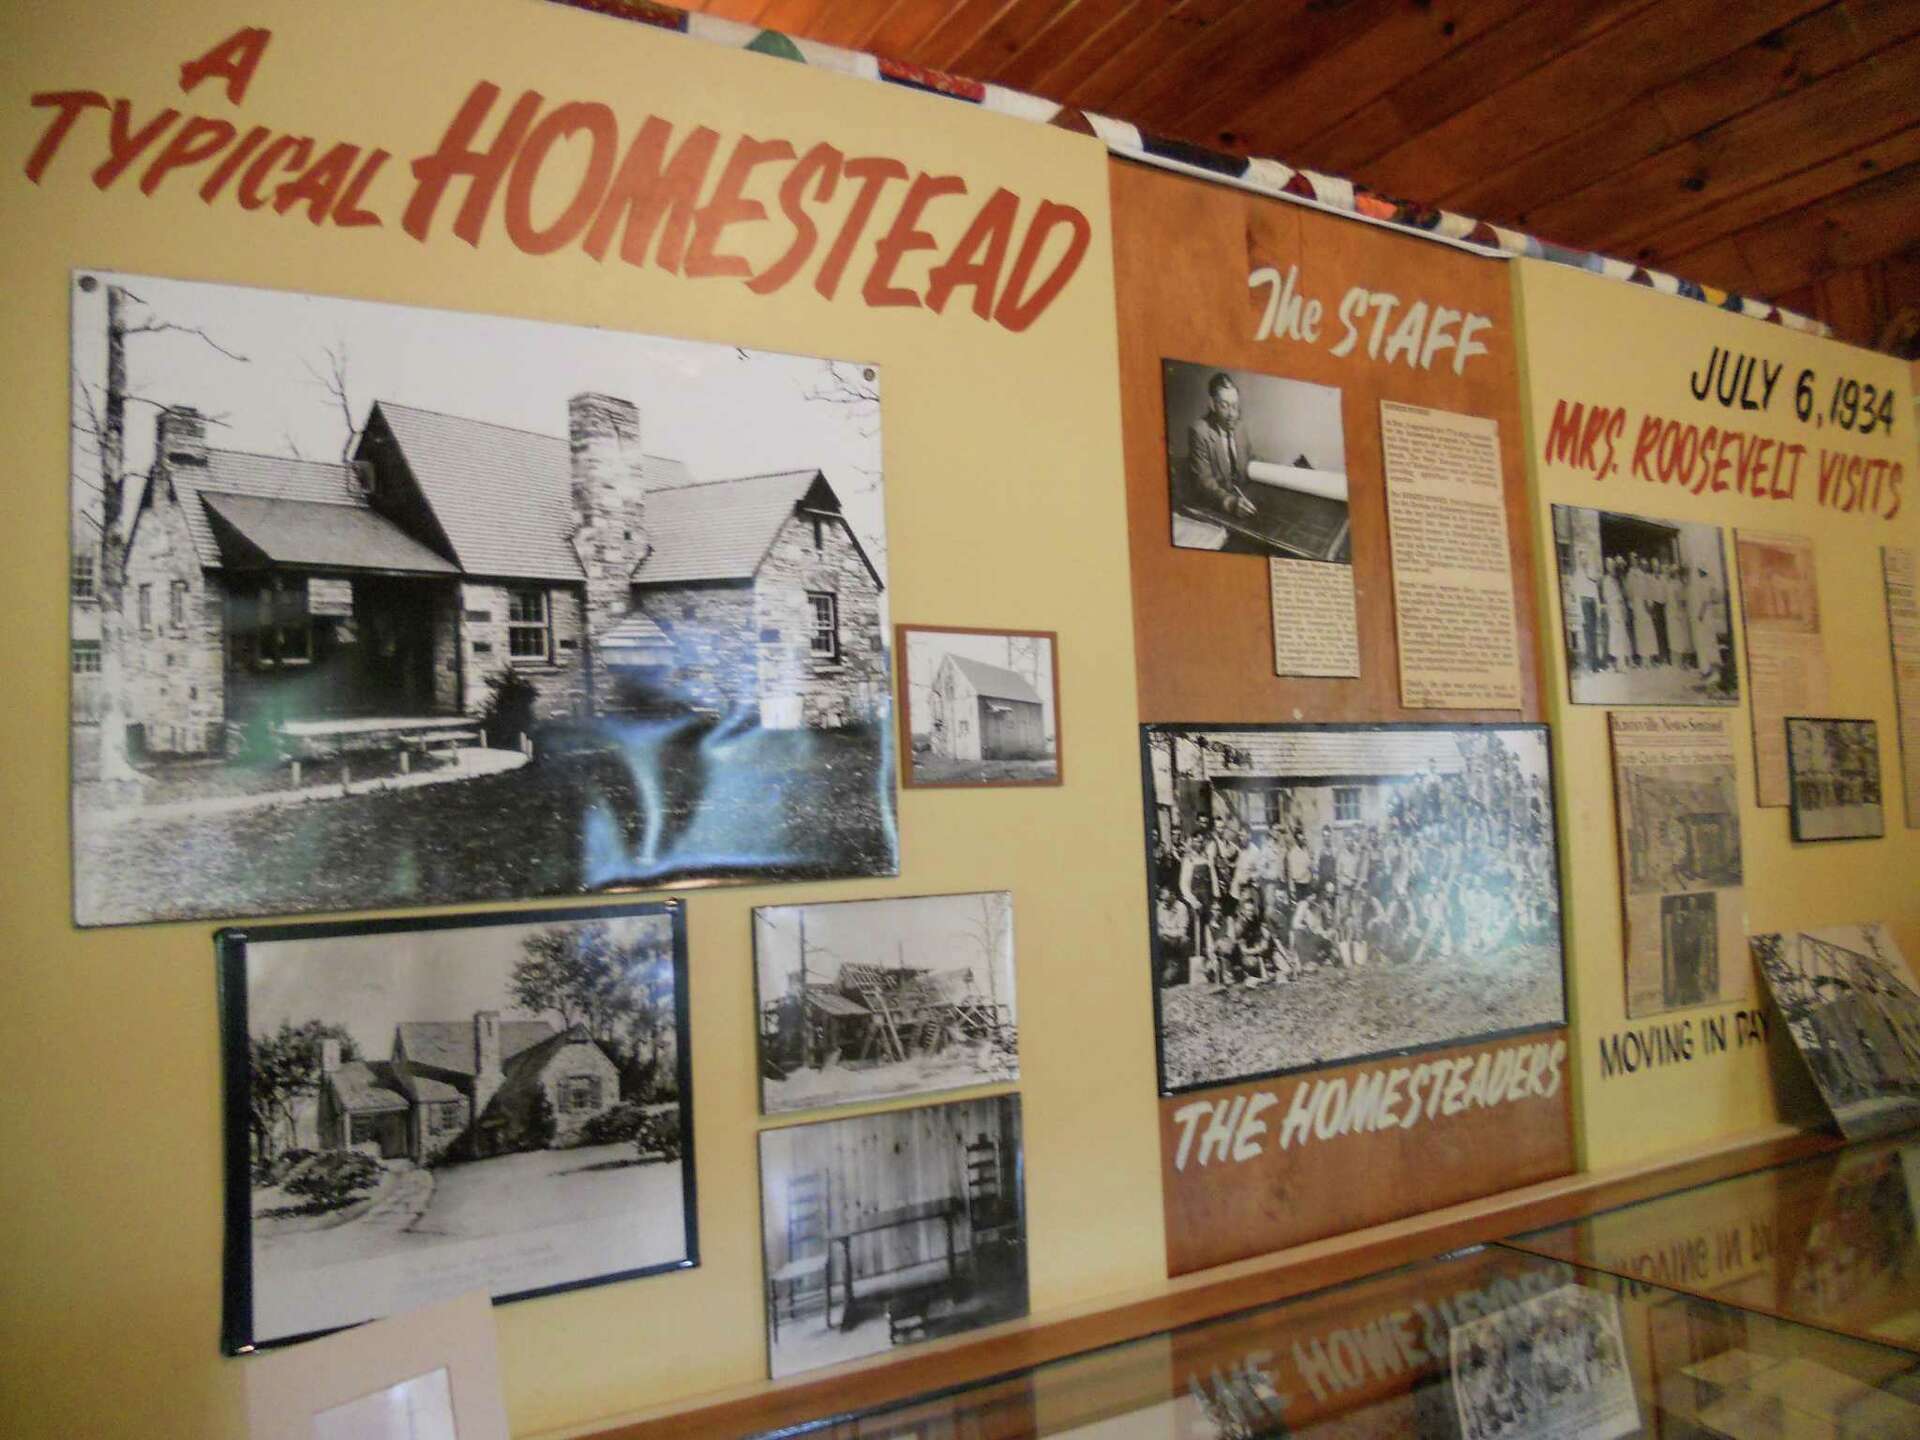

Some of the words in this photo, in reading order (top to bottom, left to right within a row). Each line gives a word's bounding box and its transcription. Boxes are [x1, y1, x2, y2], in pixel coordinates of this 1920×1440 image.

[178, 26, 272, 106] A
[24, 90, 392, 228] TYPICAL
[401, 79, 1092, 333] HOMESTEAD
[1248, 264, 1324, 344] The
[1329, 287, 1493, 376] STAFF
[1691, 346, 1783, 411] JULY
[1545, 399, 1626, 480] MRS.
[1632, 414, 1808, 500] ROOSEVELT
[1817, 448, 1904, 520] VISITS
[1599, 1020, 1694, 1080] MOVING
[1702, 1013, 1728, 1055] IN
[1173, 1092, 1278, 1172] THE
[1280, 1040, 1567, 1150] HOMESTEADERS
